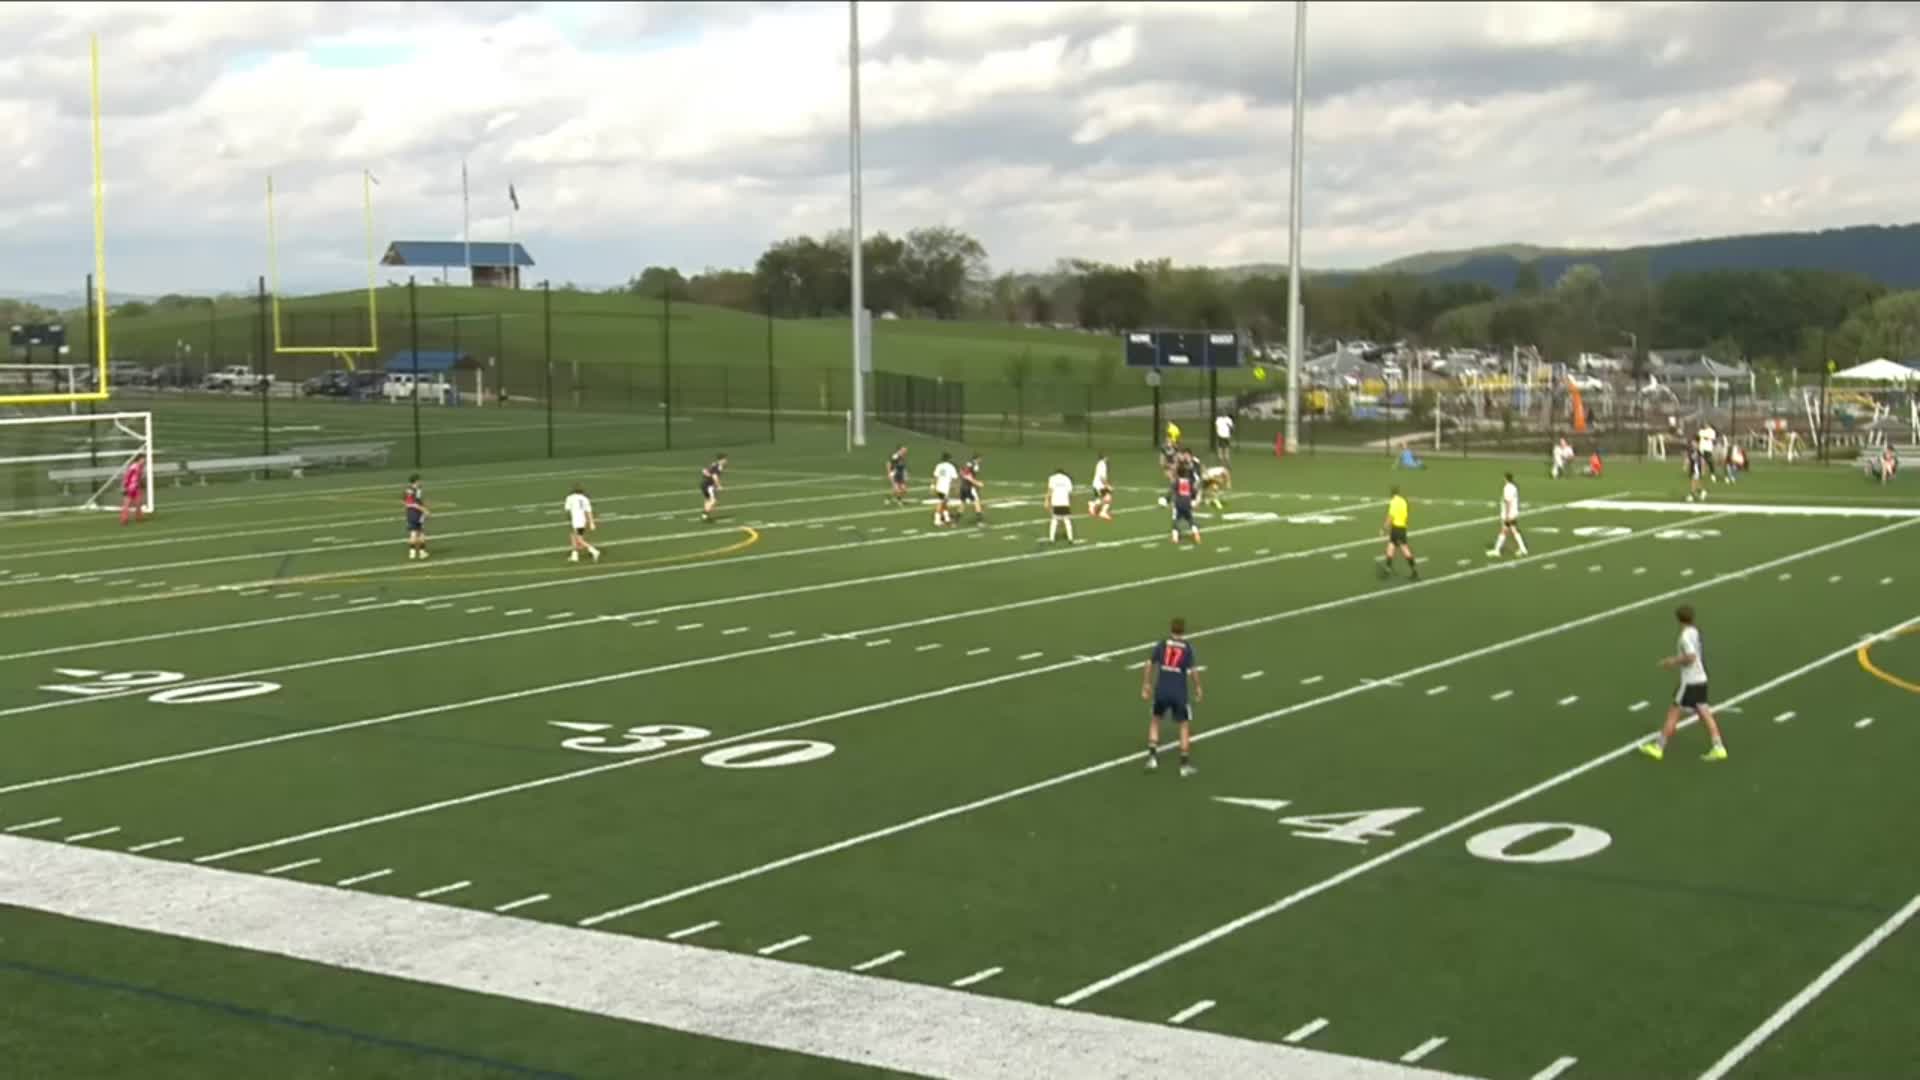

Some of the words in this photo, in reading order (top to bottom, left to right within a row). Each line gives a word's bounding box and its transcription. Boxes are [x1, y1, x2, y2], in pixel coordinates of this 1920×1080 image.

[1164, 646, 1184, 667] 17
[561, 724, 836, 769] 30
[1277, 806, 1613, 864] 40
